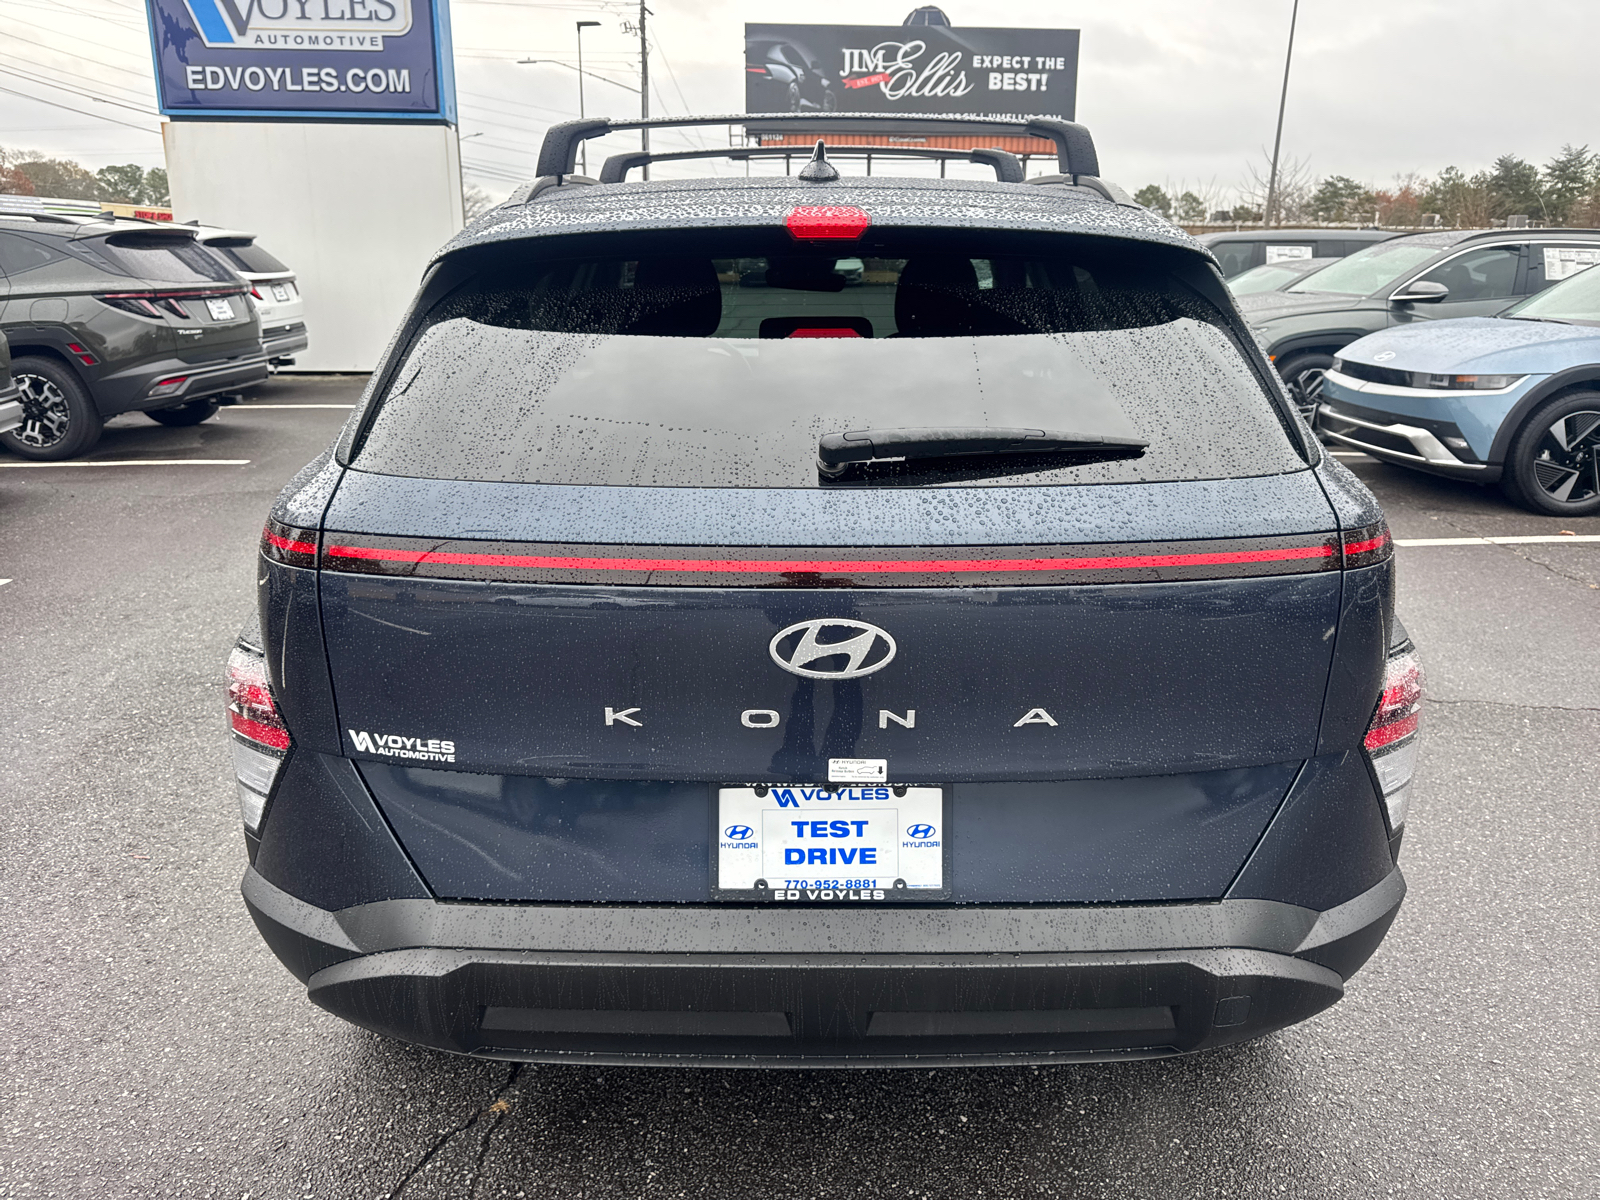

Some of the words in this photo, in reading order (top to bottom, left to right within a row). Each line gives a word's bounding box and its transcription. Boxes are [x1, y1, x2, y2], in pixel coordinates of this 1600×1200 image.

[254, 34, 379, 47] AUTOMOTIVE
[839, 48, 886, 77] JIM
[871, 40, 975, 100] Ellis
[972, 55, 1031, 69] EXPECT
[1035, 57, 1066, 70] THE
[185, 65, 411, 94] EDVOYLES.COM
[988, 72, 1048, 92] BEST!
[373, 733, 456, 754] VOYLES
[377, 747, 456, 763] AUTOMOTIVE
[800, 787, 890, 801] VOYLES
[791, 820, 869, 838] TEST
[784, 847, 877, 865] DRIVE
[784, 879, 877, 890] 770-952-8881
[774, 889, 801, 901] ED
[807, 889, 886, 901] VOYLES
